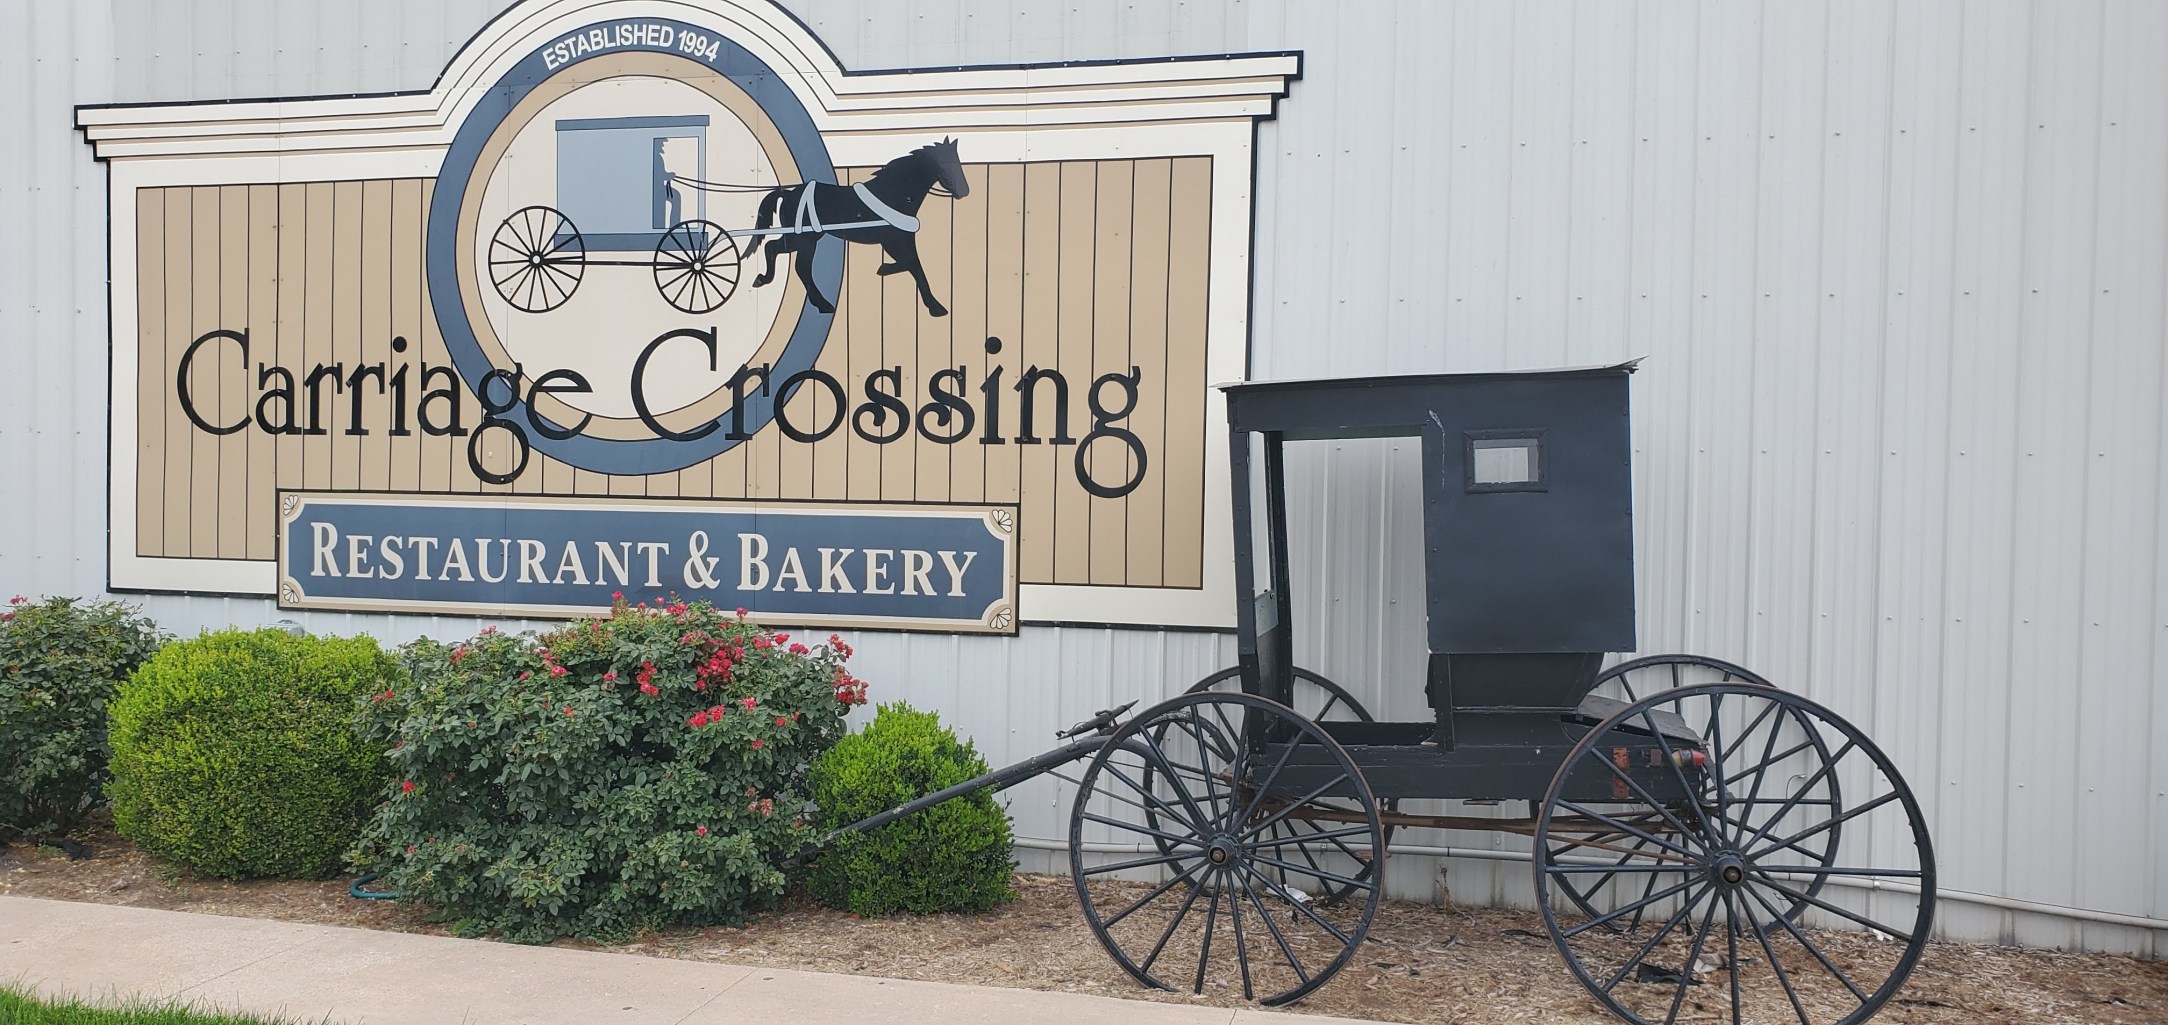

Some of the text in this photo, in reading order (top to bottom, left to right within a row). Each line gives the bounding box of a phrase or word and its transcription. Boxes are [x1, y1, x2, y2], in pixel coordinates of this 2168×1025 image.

[542, 24, 720, 70] ESTABLISHED 1994
[177, 326, 1147, 498] Carriage Crossing
[310, 521, 978, 597] RESTAURANT & BAKERY
